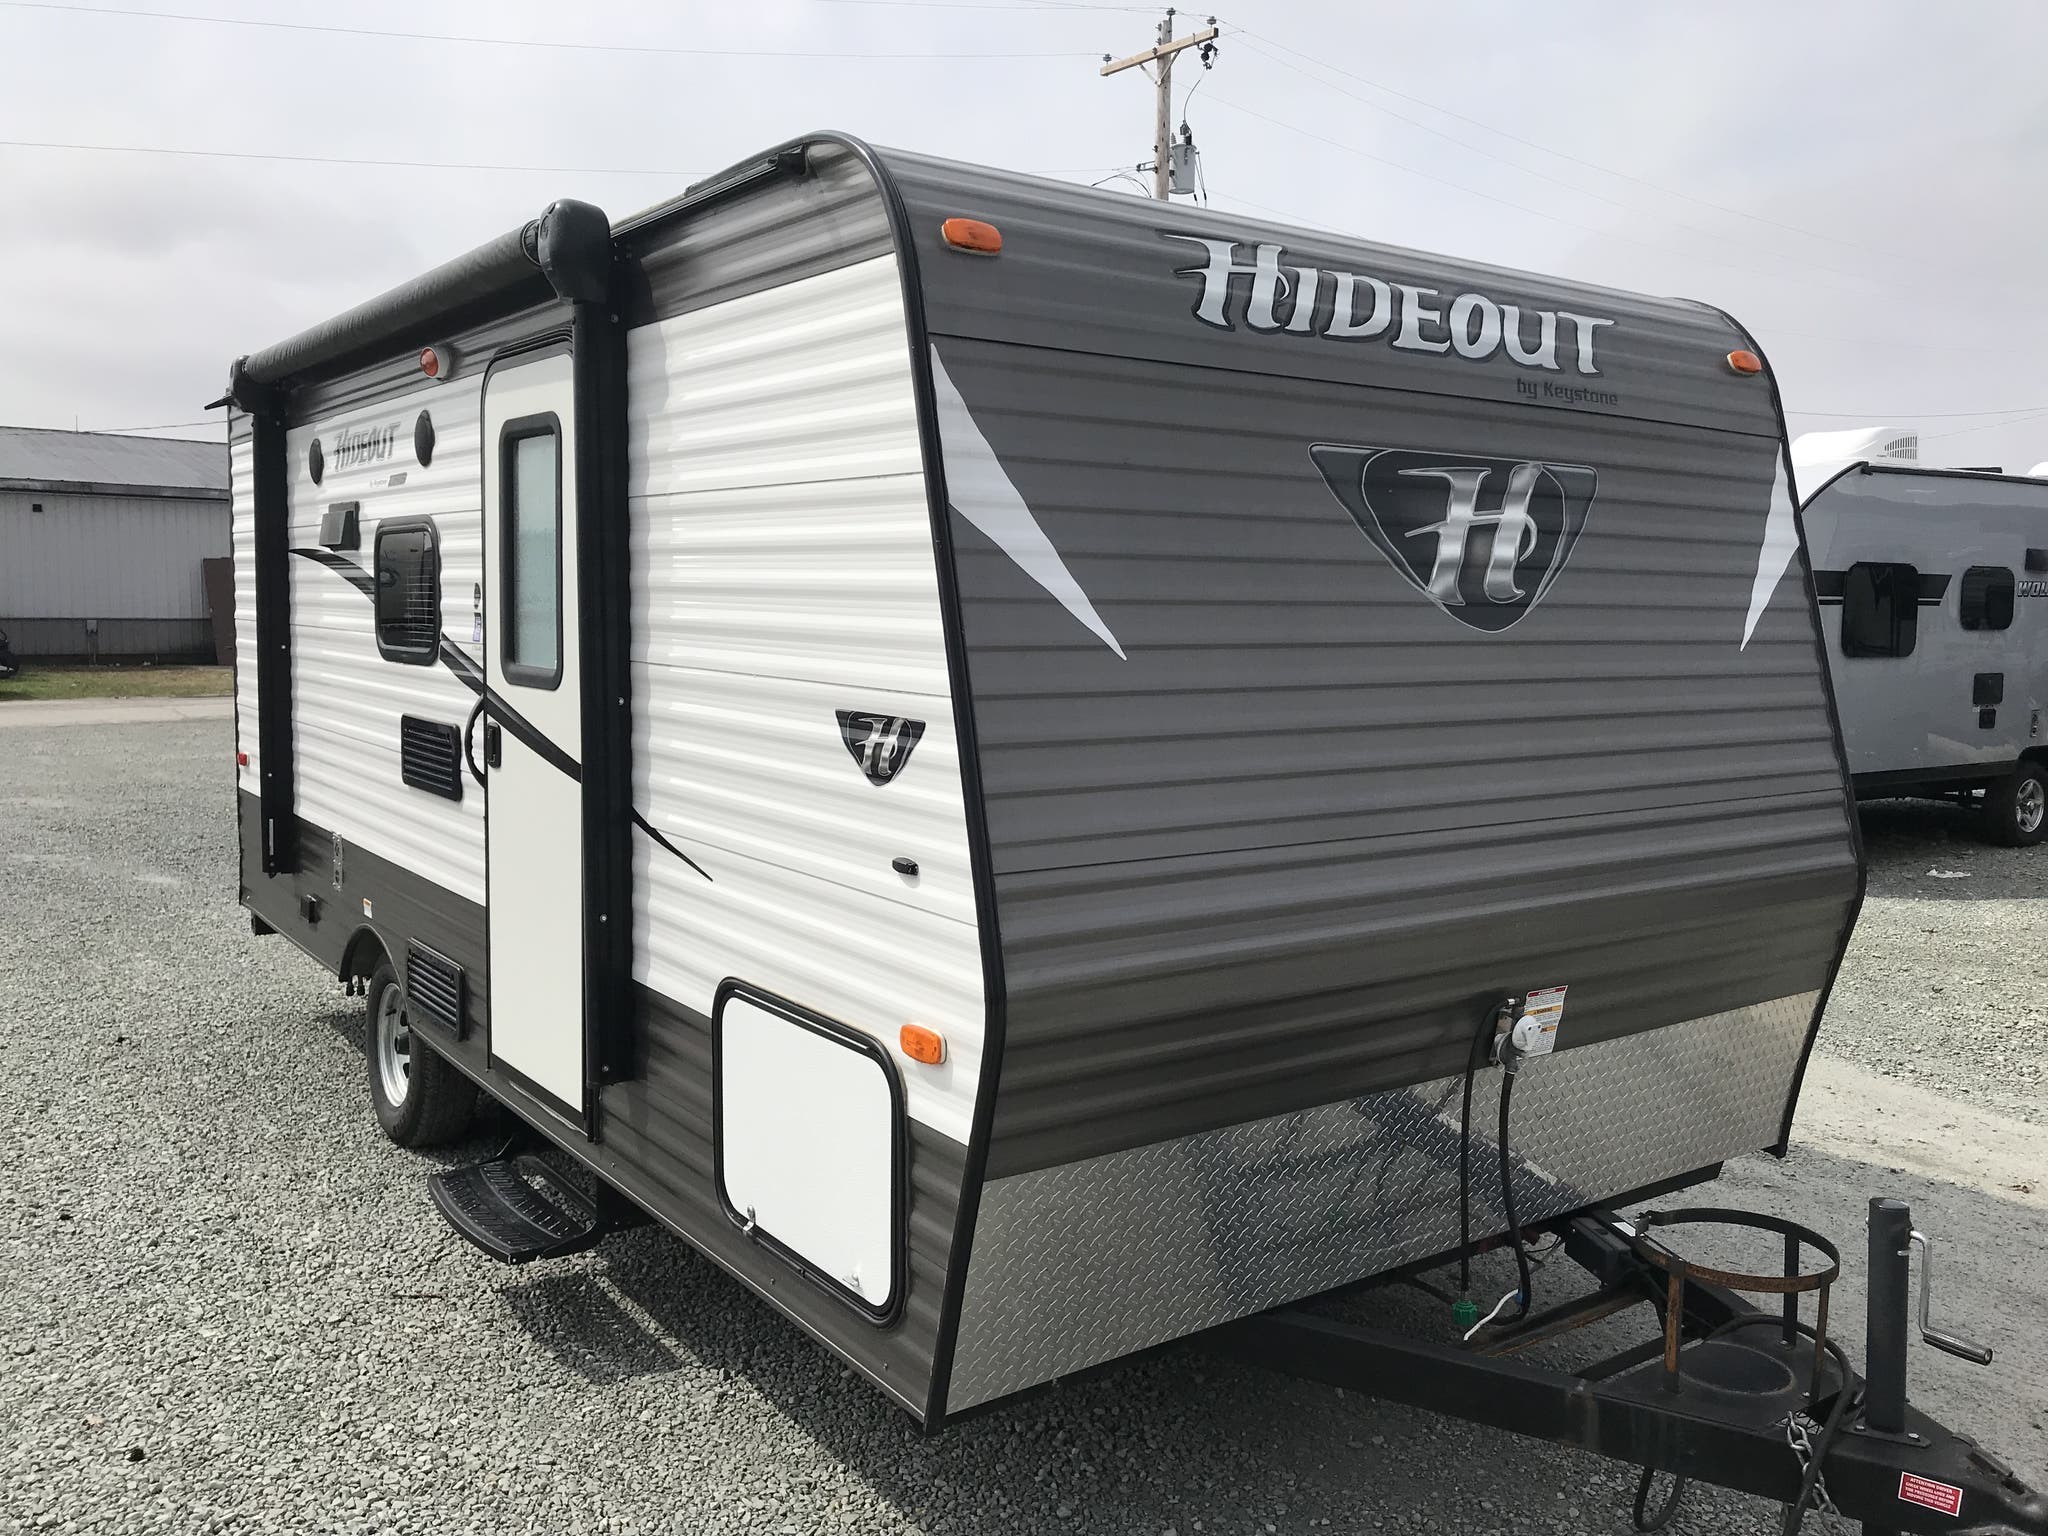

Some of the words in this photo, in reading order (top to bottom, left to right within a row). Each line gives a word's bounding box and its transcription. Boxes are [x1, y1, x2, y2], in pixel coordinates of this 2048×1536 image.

[1162, 233, 1615, 375] HIDEOUT
[1517, 378, 1538, 399] by
[1543, 382, 1618, 405] Keystone
[333, 422, 401, 472] HIDEOUT
